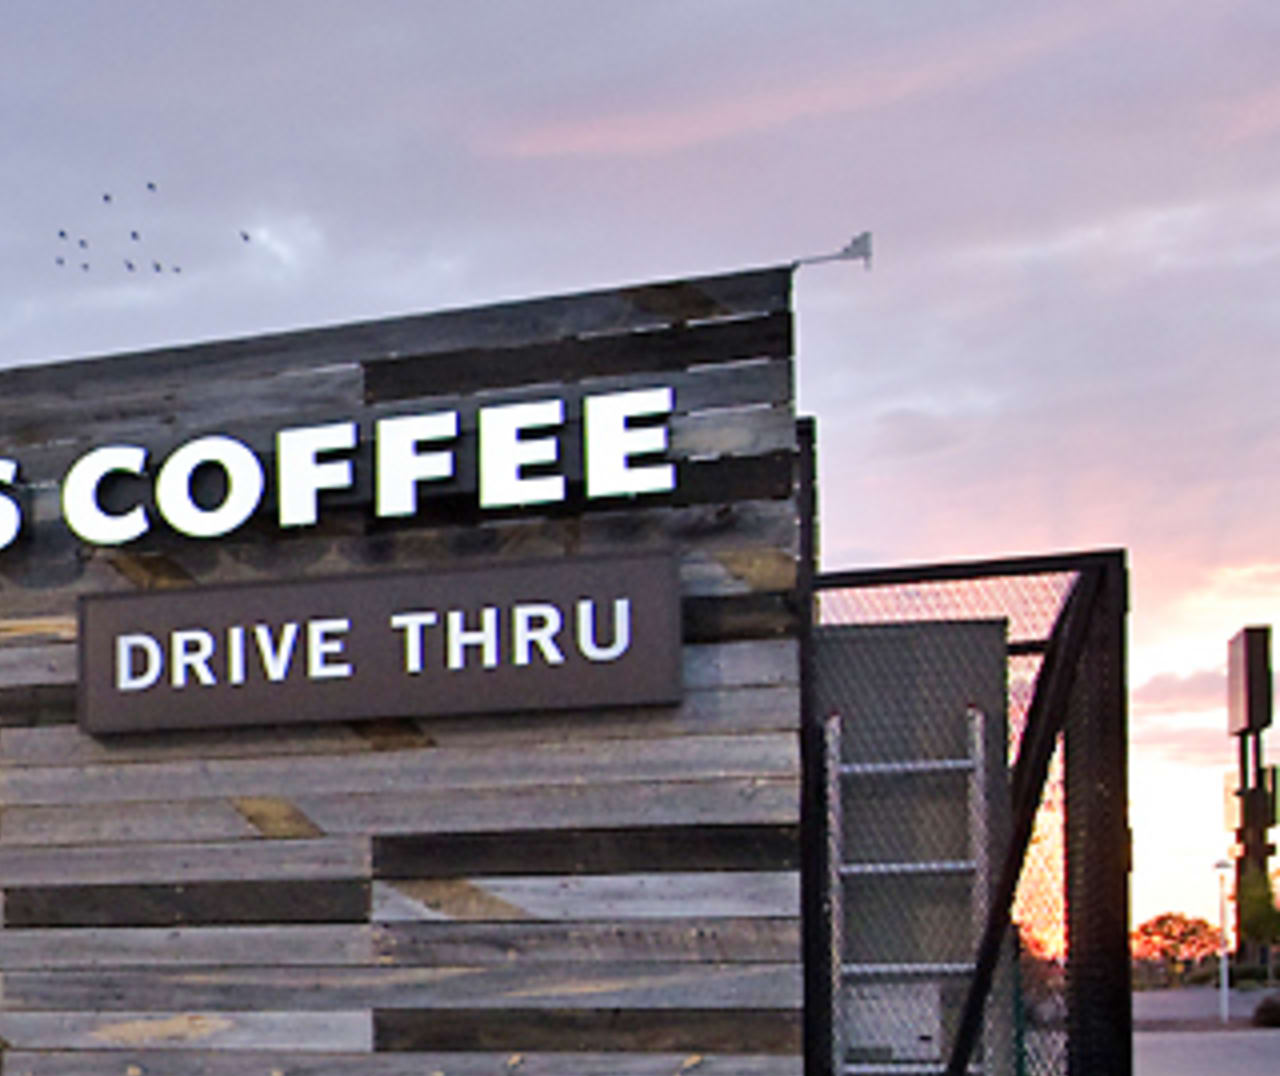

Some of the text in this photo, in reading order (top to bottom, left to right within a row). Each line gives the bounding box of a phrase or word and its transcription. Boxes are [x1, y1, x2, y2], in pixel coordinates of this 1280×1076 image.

[61, 386, 676, 546] COFFEE
[115, 597, 631, 692] DRIVE THRU
